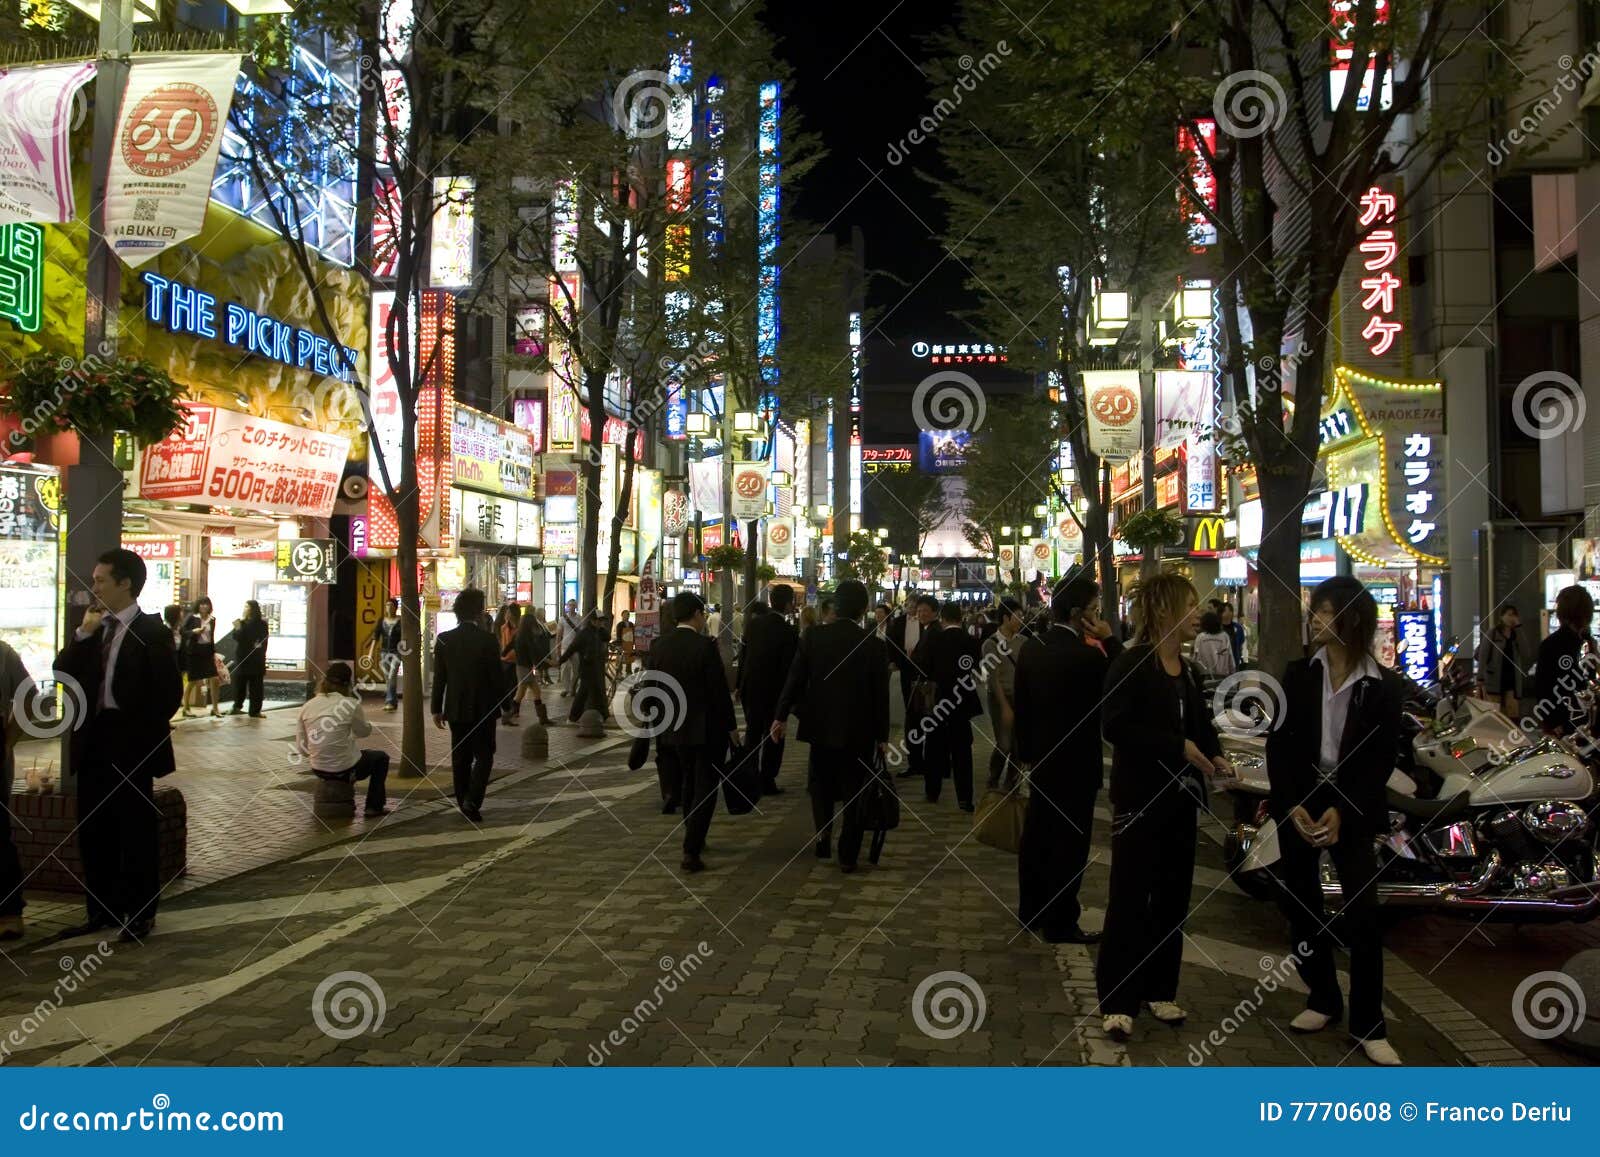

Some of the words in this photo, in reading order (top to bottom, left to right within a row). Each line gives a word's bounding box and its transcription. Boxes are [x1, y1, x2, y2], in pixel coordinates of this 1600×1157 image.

[1359, 186, 1402, 357] カラオケ
[144, 272, 216, 338] THE
[228, 304, 292, 365] PICK
[1189, 493, 1213, 508] 2F
[1319, 483, 1369, 539] 747
[1403, 433, 1436, 545] カラオケ
[353, 520, 366, 553] 2F
